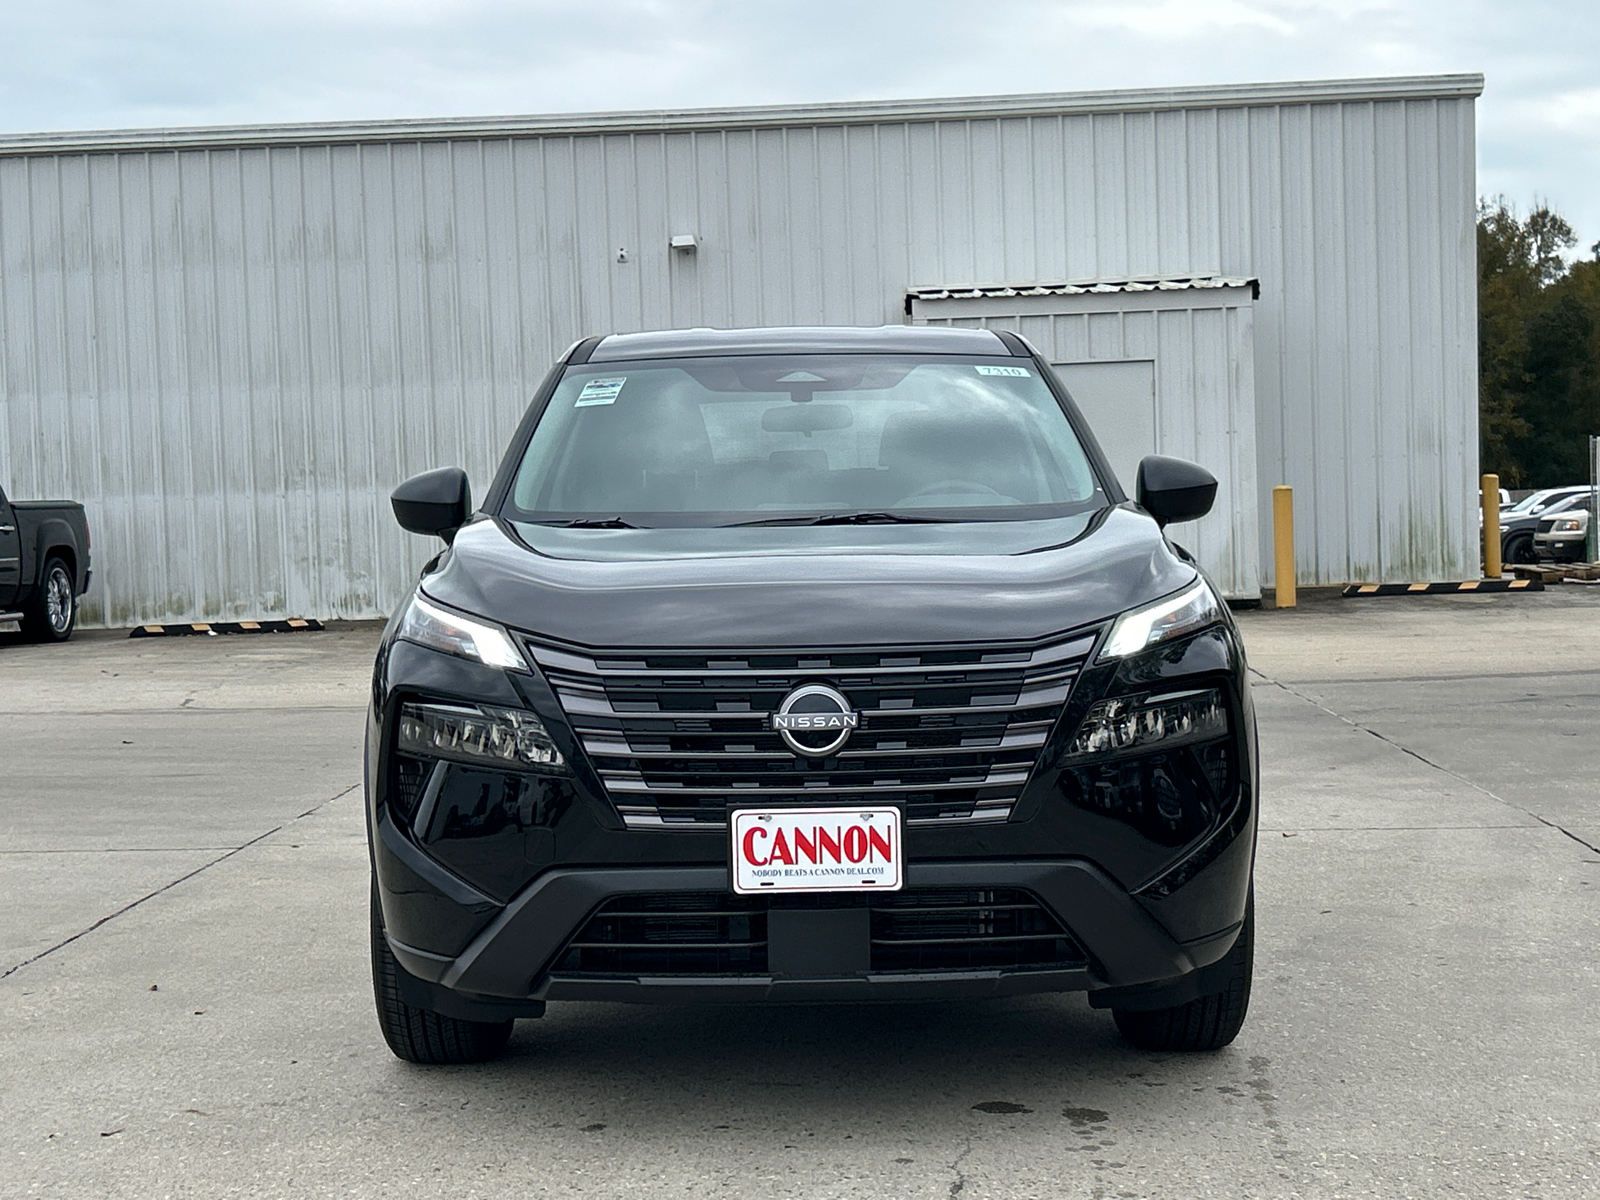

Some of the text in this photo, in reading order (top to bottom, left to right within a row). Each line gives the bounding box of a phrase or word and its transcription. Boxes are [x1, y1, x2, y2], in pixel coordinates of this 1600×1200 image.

[982, 367, 1021, 376] 7310
[775, 716, 856, 728] NISSAN
[743, 825, 891, 867] CANNON
[752, 869, 782, 877] NOBODY
[784, 869, 808, 877] BEATS
[815, 868, 845, 876] CANNON
[846, 867, 884, 875] DEAL.COM
